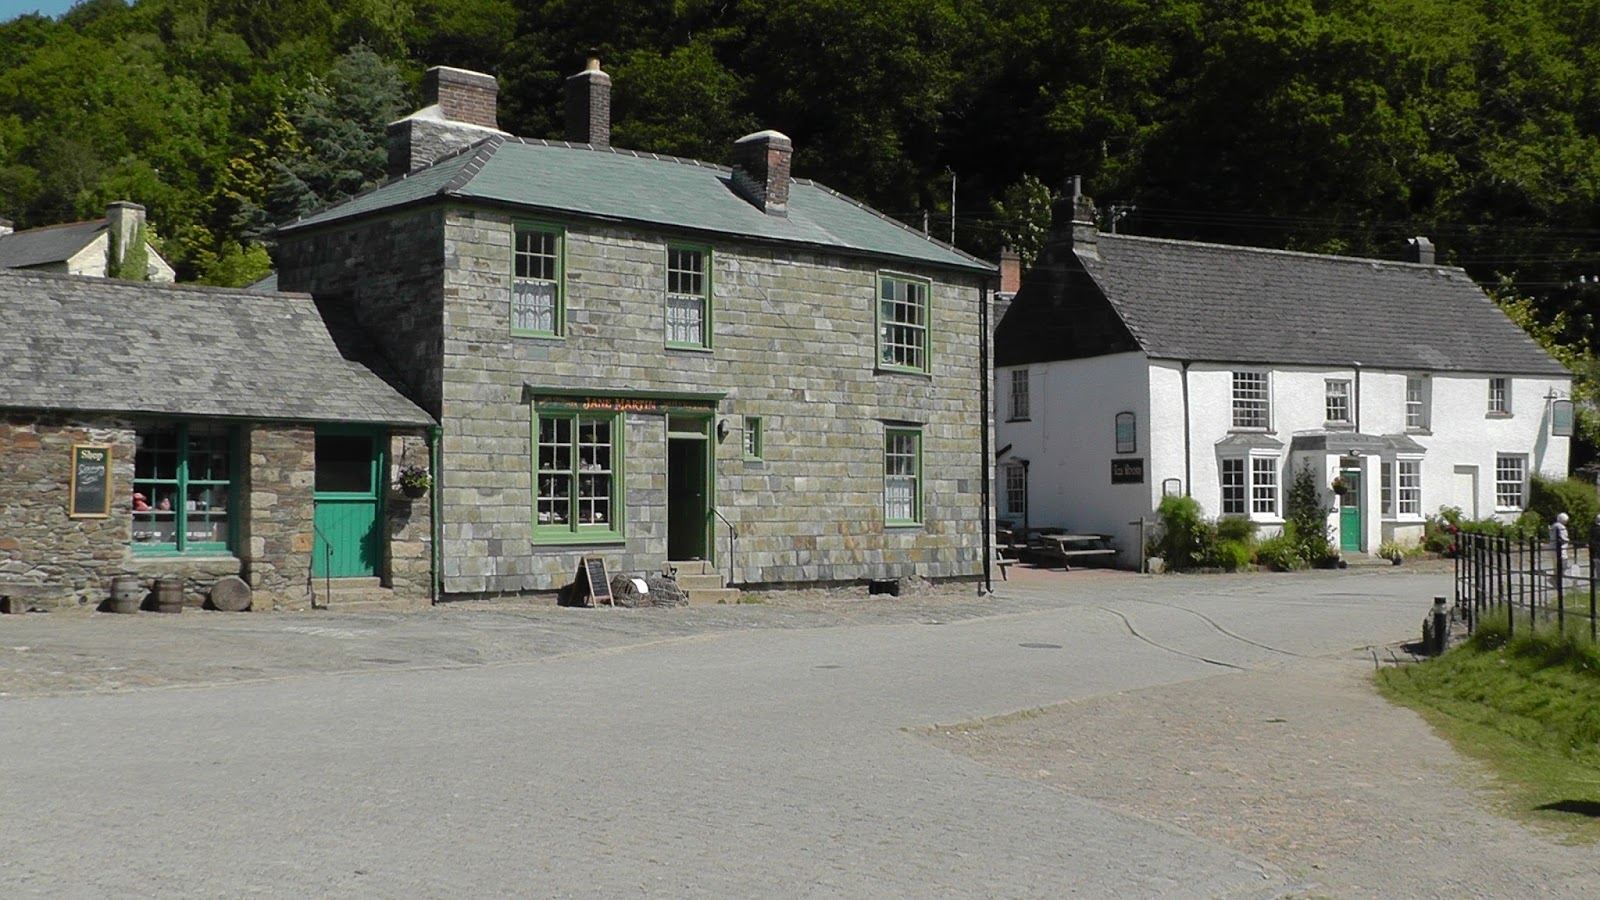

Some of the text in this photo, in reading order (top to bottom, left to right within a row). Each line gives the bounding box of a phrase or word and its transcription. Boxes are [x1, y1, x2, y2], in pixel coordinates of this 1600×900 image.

[582, 397, 612, 410] JANE
[614, 398, 658, 411] MARTIN
[81, 449, 103, 461] Shop
